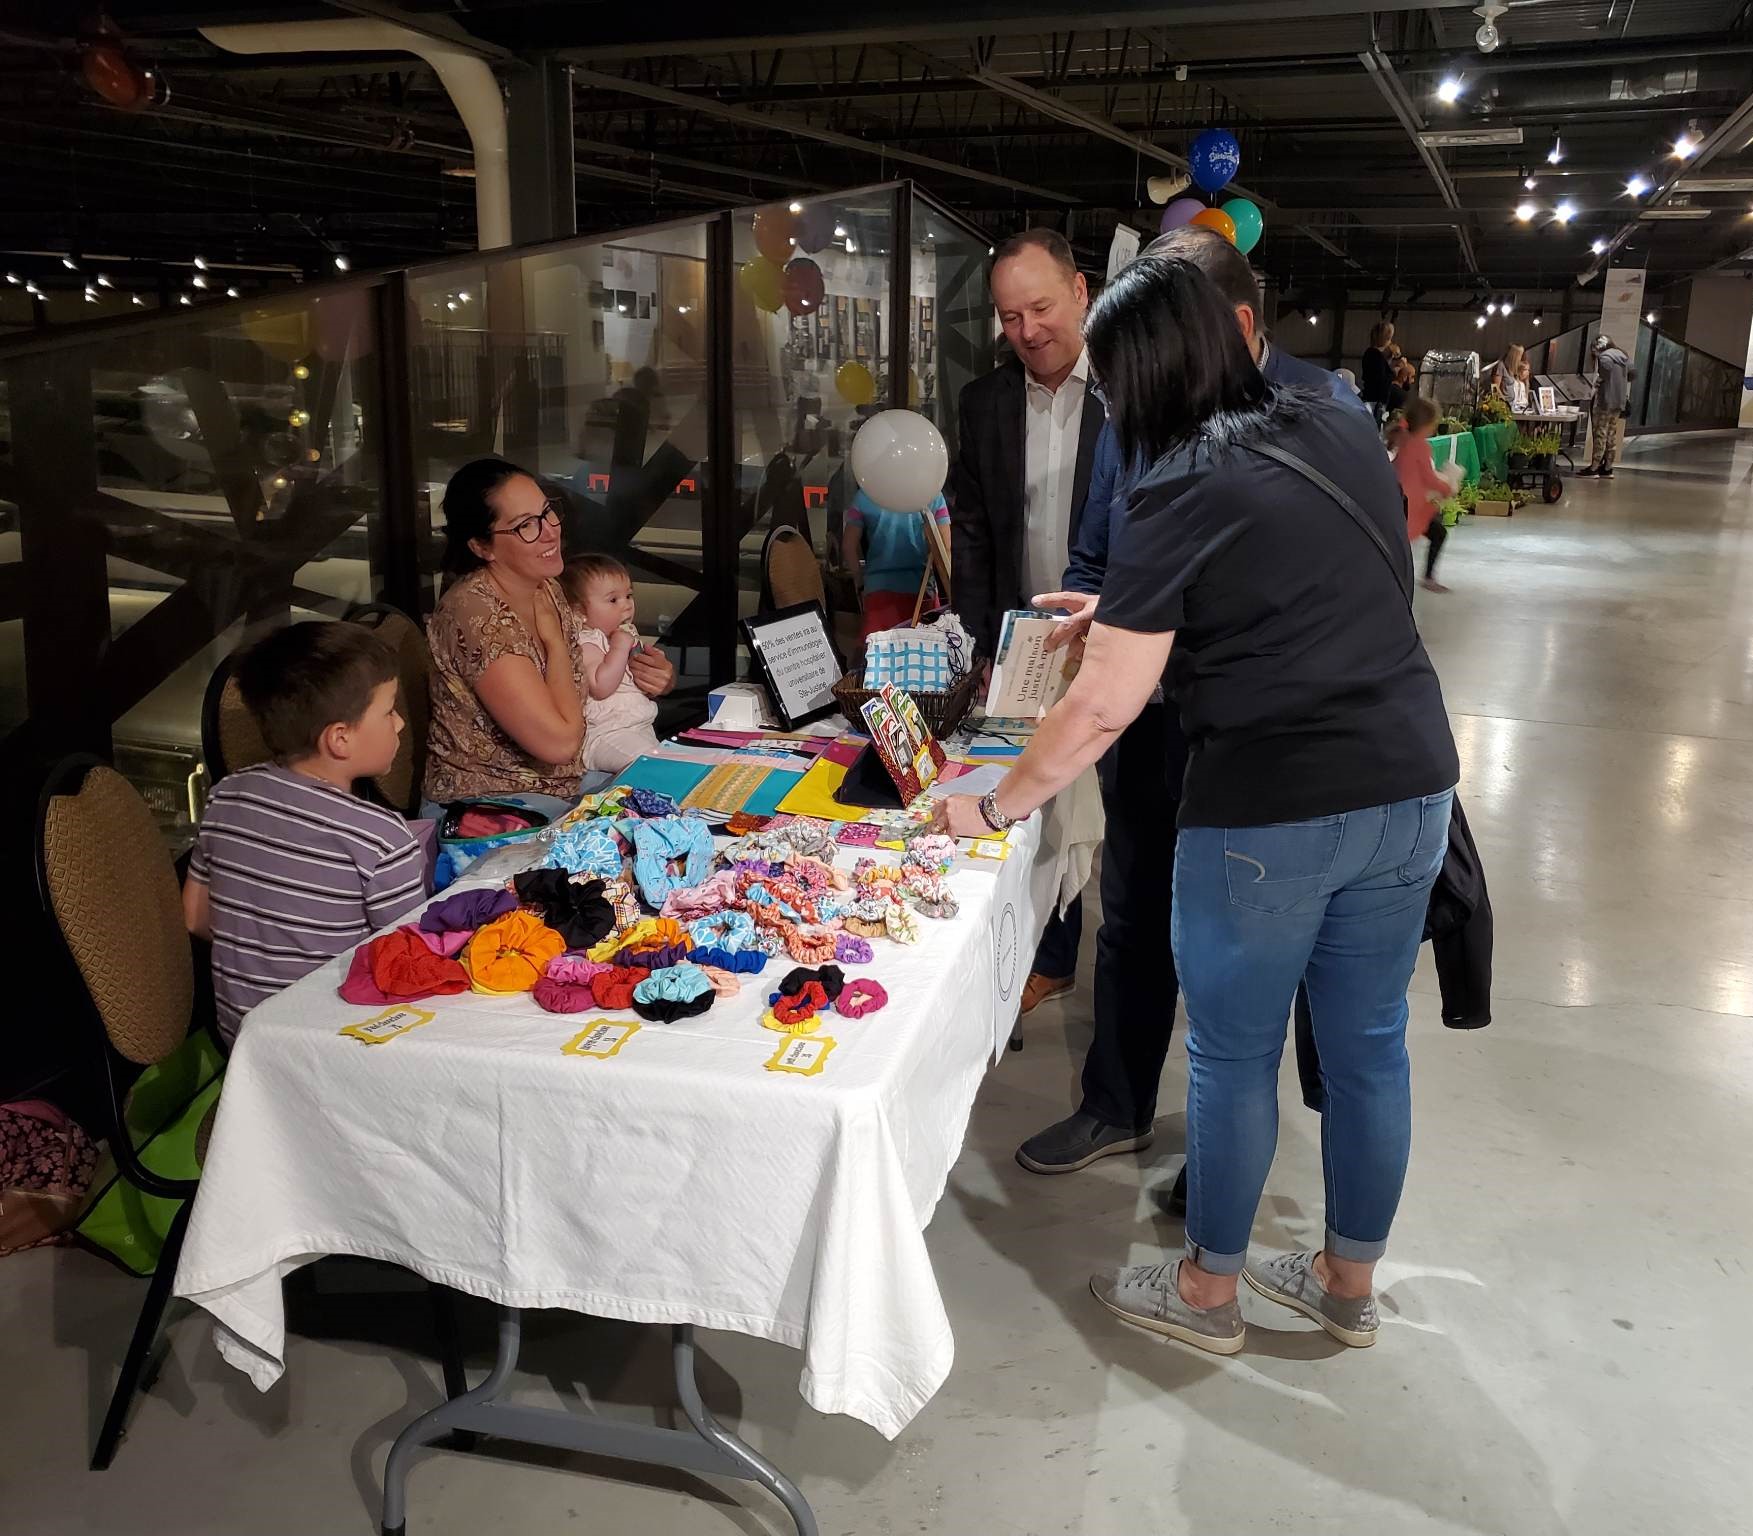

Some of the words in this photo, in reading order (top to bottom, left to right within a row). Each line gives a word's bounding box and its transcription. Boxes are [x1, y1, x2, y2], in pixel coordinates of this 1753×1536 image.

[775, 637, 786, 646] des
[785, 632, 803, 642] ventes
[810, 626, 818, 634] au
[768, 652, 787, 664] service
[776, 667, 784, 677] du
[784, 662, 801, 674] centre
[800, 652, 826, 666] hospitalier
[788, 670, 819, 688] universitaire
[818, 667, 826, 675] de
[1016, 680, 1030, 702] Une
[1025, 635, 1042, 676] maison
[798, 682, 827, 699] Ste-Justine
